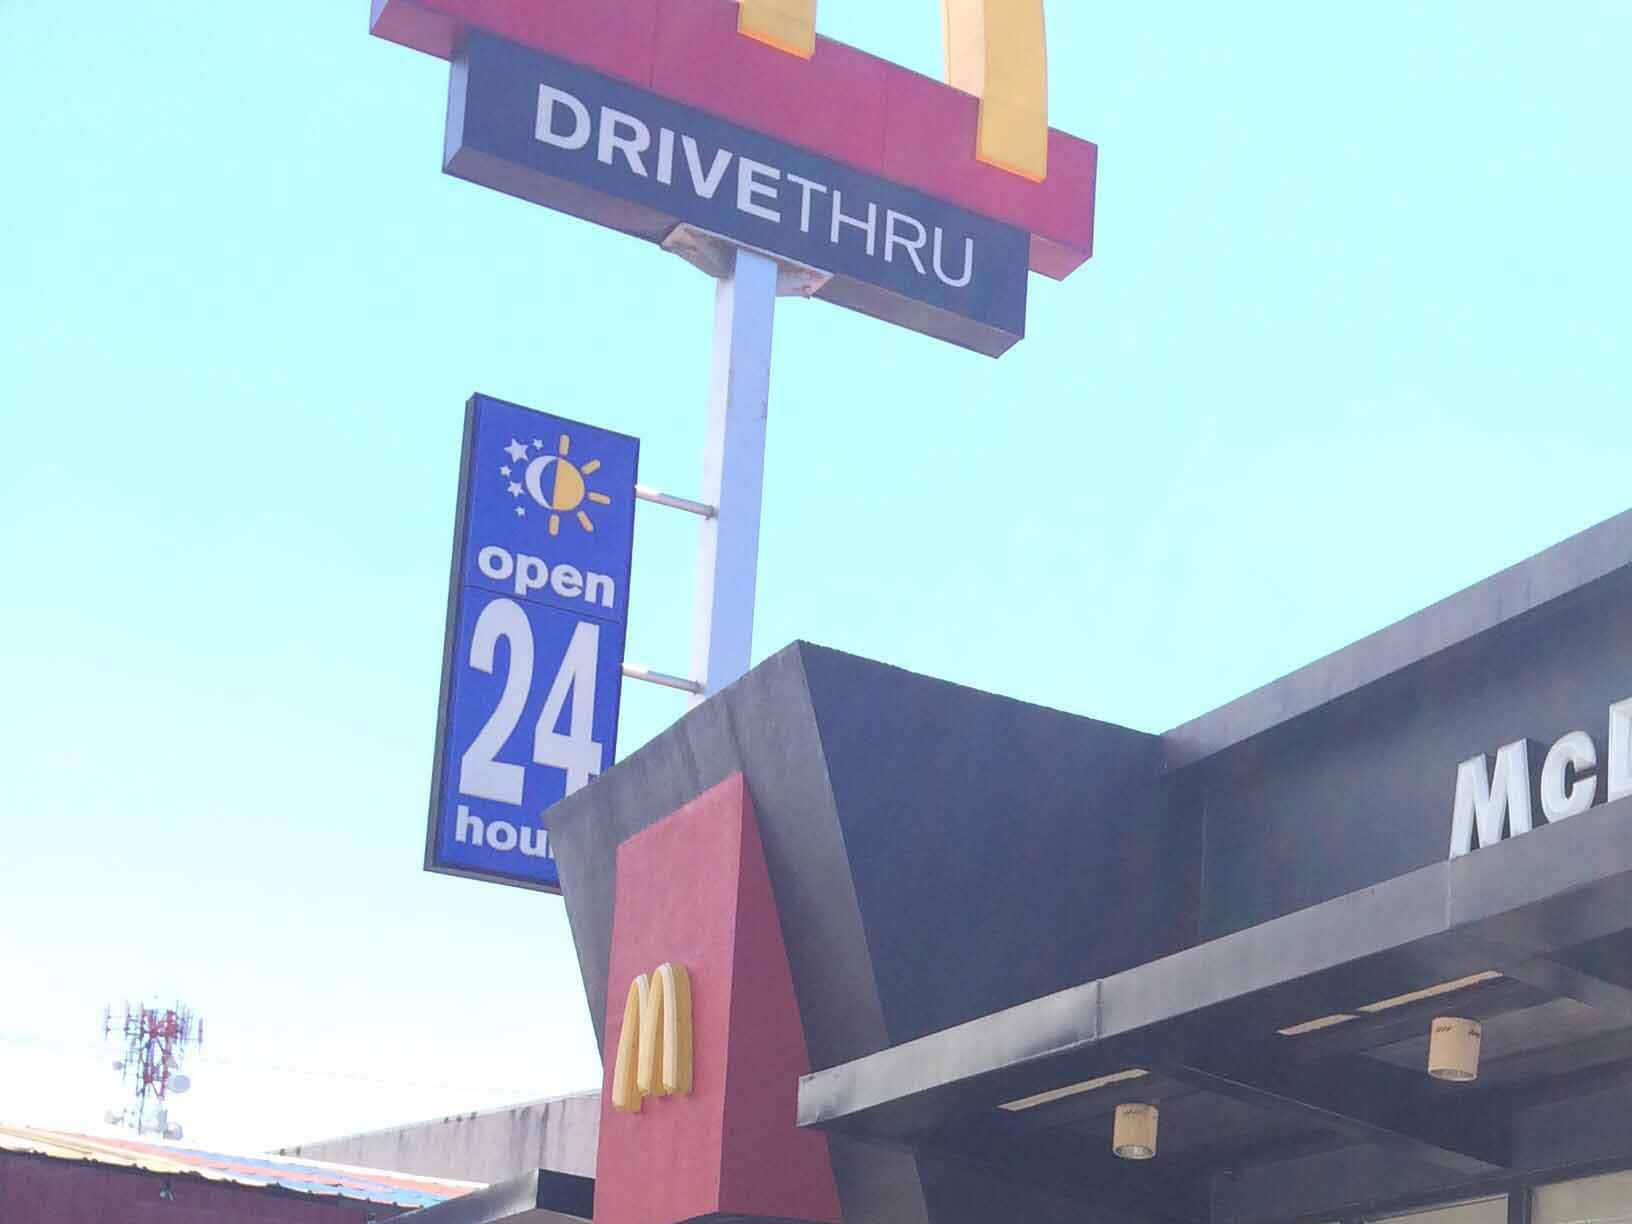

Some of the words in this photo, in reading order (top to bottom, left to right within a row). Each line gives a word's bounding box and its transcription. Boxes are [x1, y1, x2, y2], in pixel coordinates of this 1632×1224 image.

[477, 544, 616, 609] open
[459, 597, 602, 807] 24
[455, 806, 554, 860] hou
